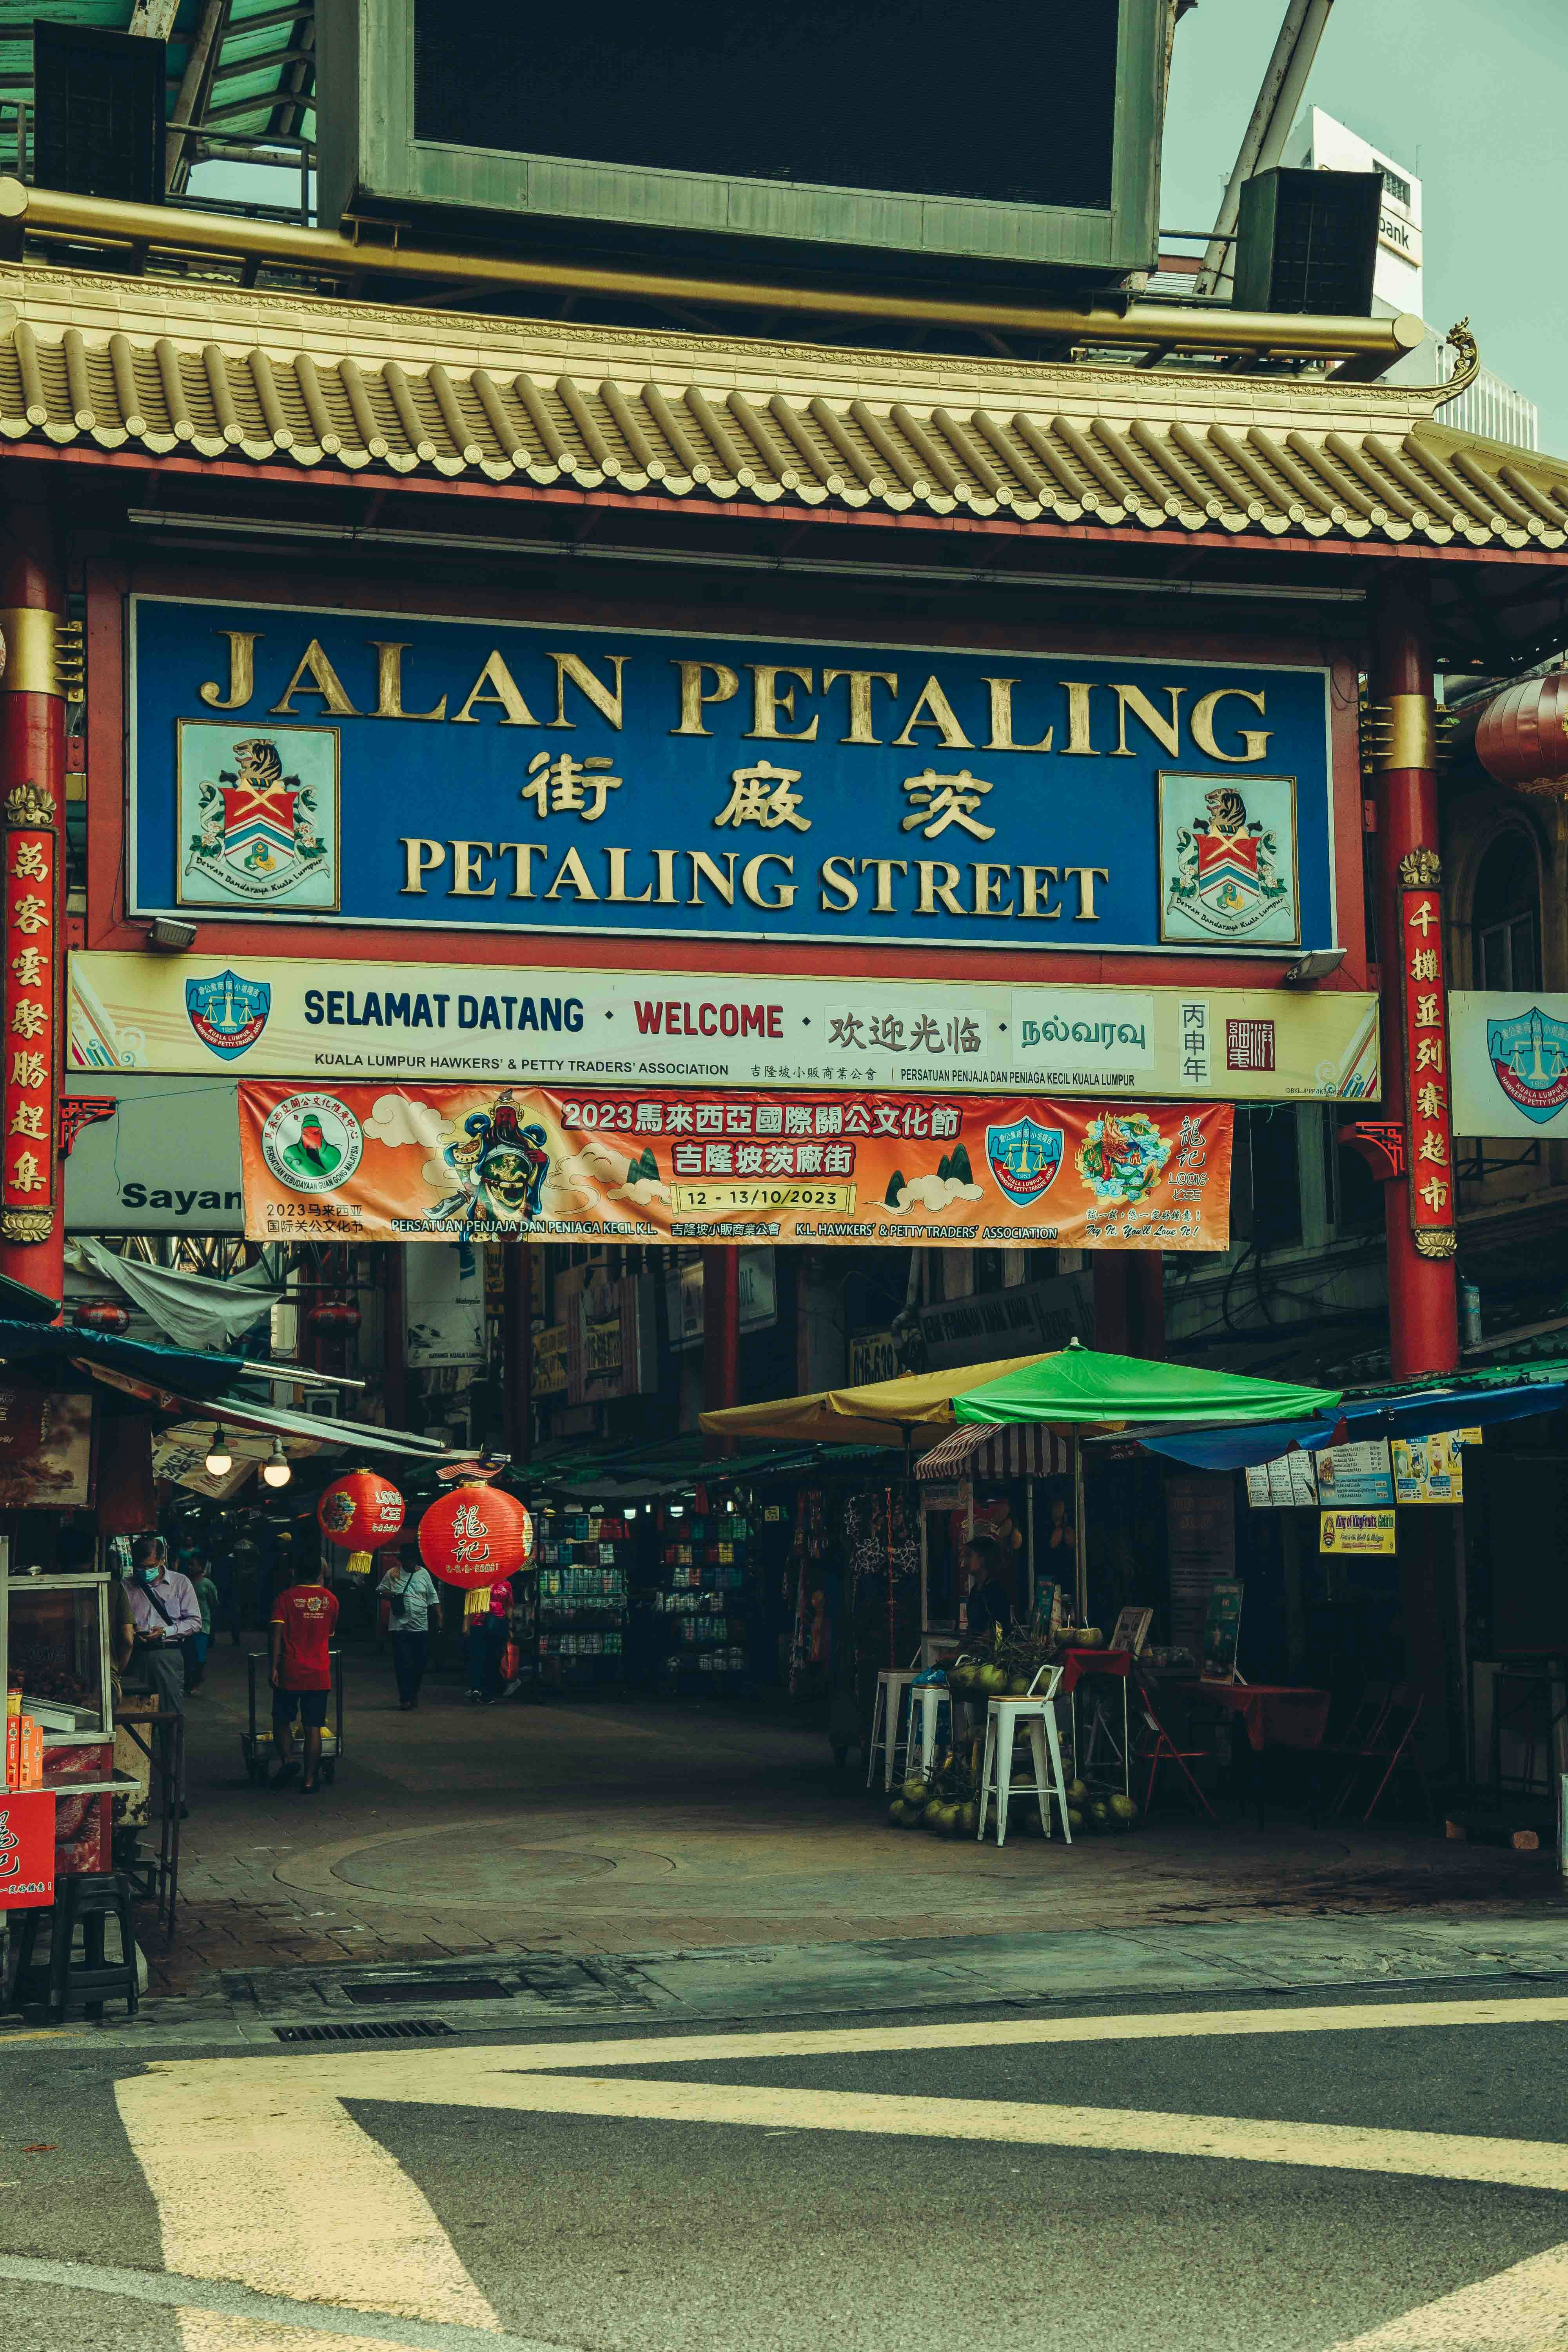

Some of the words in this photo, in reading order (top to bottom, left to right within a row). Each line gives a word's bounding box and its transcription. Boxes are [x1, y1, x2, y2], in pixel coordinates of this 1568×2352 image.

[200, 630, 632, 730] JALAN
[670, 660, 1274, 763] PETALING
[196, 857, 223, 878] Dewan
[225, 876, 269, 895] Bandaraya
[271, 878, 294, 891] Kuala
[295, 858, 322, 880] Lumpur
[400, 838, 800, 909] PETALING
[821, 855, 1109, 920] STREET
[1176, 897, 1200, 916] Dewan
[1201, 914, 1238, 932] Bandaraya
[1240, 916, 1259, 928] Kuala
[1259, 897, 1284, 917] Lumpur
[304, 989, 450, 1028] SELAMAT
[458, 995, 584, 1033] DATANG
[633, 1000, 784, 1038] WELCOME
[208, 1028, 226, 1040] KUALA
[228, 1030, 250, 1042] LUMPUR
[828, 1011, 982, 1054] 欢迎光临
[1022, 1014, 1145, 1051] நல்வரவு
[1182, 1004, 1207, 1082] 丙申年
[314, 1053, 363, 1065] KUALA
[367, 1054, 426, 1067] LUMPUR
[507, 1058, 518, 1070] &
[521, 1059, 564, 1071] PETTY
[638, 1062, 729, 1076] ASSOCIATION
[901, 1068, 950, 1082] PERSATUAN
[952, 1069, 989, 1083] PENJAJA
[990, 1070, 1008, 1083] DAN
[1009, 1071, 1045, 1084] PENIAGA
[1047, 1072, 1071, 1085] KECIL
[1072, 1073, 1100, 1085] KUALA
[1101, 1074, 1135, 1086] LUMPUR
[1515, 1083, 1537, 1098] KUALA
[1539, 1084, 1564, 1098] LUMPUR
[1176, 1116, 1207, 1168] 龍記
[265, 1145, 285, 1176] PERSATUAN
[283, 1172, 318, 1190] KEBUDAYAAN
[318, 1178, 334, 1190] GUAN
[333, 1169, 348, 1184] GONG
[345, 1145, 359, 1172] MALAYSIA
[675, 1143, 851, 1174] 吉隆坡茨廠街
[1007, 1174, 1021, 1187] KUALA
[1022, 1176, 1043, 1187] LUMPUR
[1168, 1172, 1209, 1186] LOONG
[688, 1192, 706, 1205] 12
[730, 1189, 837, 1205] 13/10/2023
[1172, 1188, 1202, 1201] KEE
[267, 1220, 364, 1233] 国际关公文化节
[392, 1220, 463, 1232] PERSATUAN
[466, 1220, 517, 1233] PENJAJA
[519, 1221, 545, 1233] DAN
[548, 1221, 601, 1234] PENIAGA
[603, 1222, 635, 1234] KECIL
[636, 1222, 658, 1235] K.L.
[671, 1222, 780, 1236] 吉隆坡小販商業公會
[795, 1223, 815, 1236] K.L.
[879, 1225, 887, 1237] &
[889, 1225, 926, 1237] PETTY
[982, 1227, 1058, 1240] ASSOCIATION
[1085, 1224, 1102, 1238] Try
[1154, 1225, 1177, 1236] Love
[380, 1506, 401, 1520] KEE
[451, 1504, 490, 1563] 龍記
